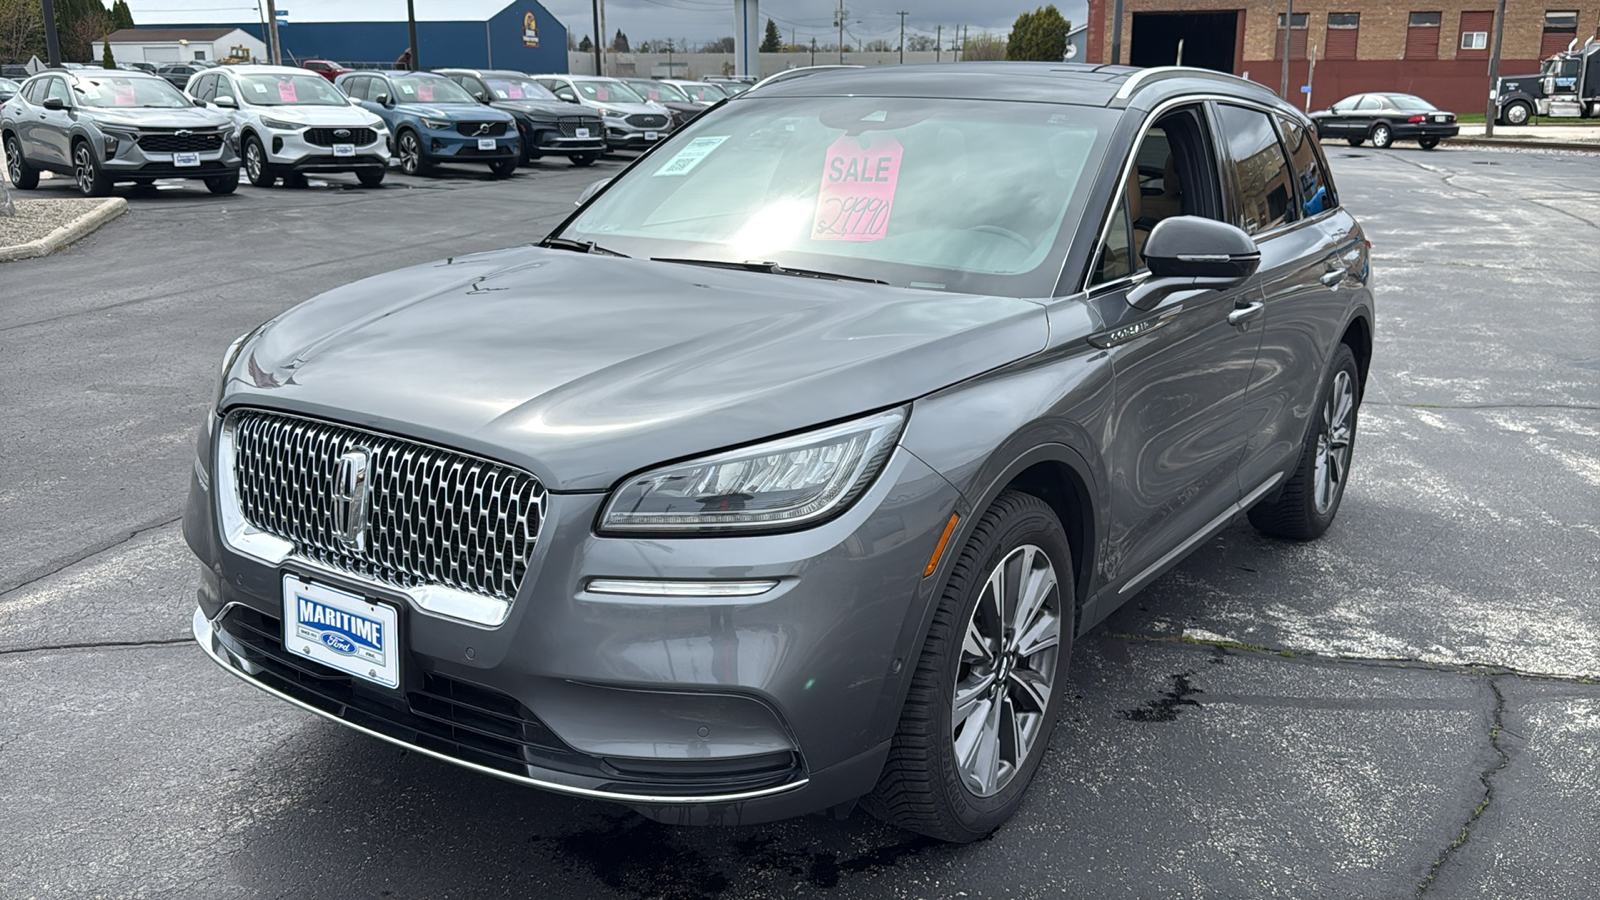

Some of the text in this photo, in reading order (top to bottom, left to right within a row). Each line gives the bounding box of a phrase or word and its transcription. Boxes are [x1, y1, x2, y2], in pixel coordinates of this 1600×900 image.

[828, 156, 892, 183] SALE
[299, 598, 382, 650] MARITIME
[326, 634, 351, 652] Ford
